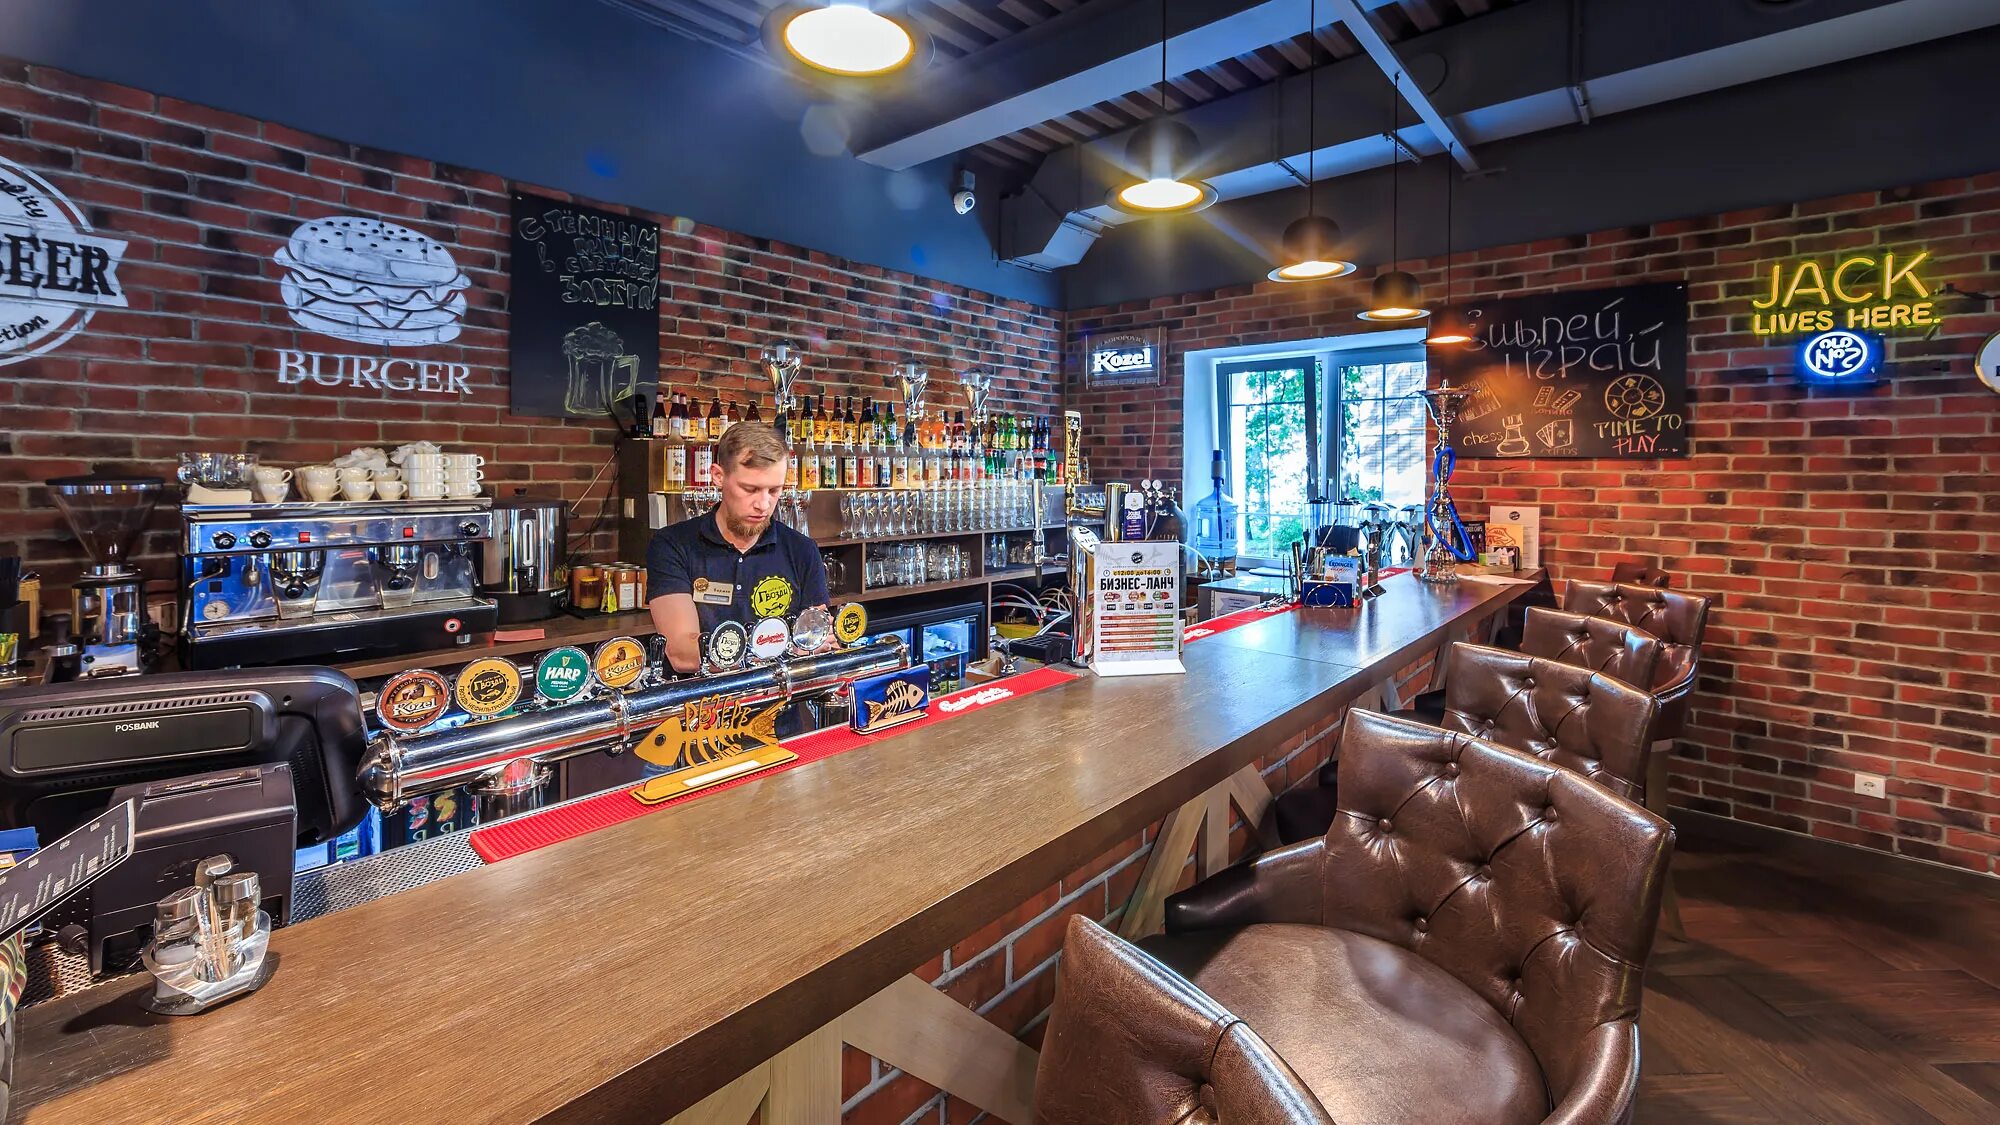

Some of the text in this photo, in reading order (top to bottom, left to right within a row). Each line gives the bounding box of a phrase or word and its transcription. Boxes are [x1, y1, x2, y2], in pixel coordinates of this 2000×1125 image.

[518, 208, 658, 254] С ТЁМНЫМ
[0, 233, 117, 296] EER
[1752, 252, 1928, 308] JACK
[559, 273, 660, 310] ЗАВТРА!
[1754, 302, 1941, 335] LIVES HERE.
[1819, 337, 1853, 349] OLD
[1091, 347, 1152, 373] Kozel
[277, 349, 472, 394] BURGER
[1592, 413, 1682, 439] TIME TO
[1463, 431, 1504, 446] chess
[1100, 576, 1174, 591] БИЗНЕС-ЛАНЧ
[759, 589, 788, 603] Гвозди
[545, 667, 582, 680] HARP
[605, 660, 641, 679] Kozel
[474, 677, 504, 692] Гвозди
[393, 697, 438, 717] Kozel
[114, 720, 160, 732] POSBANK
